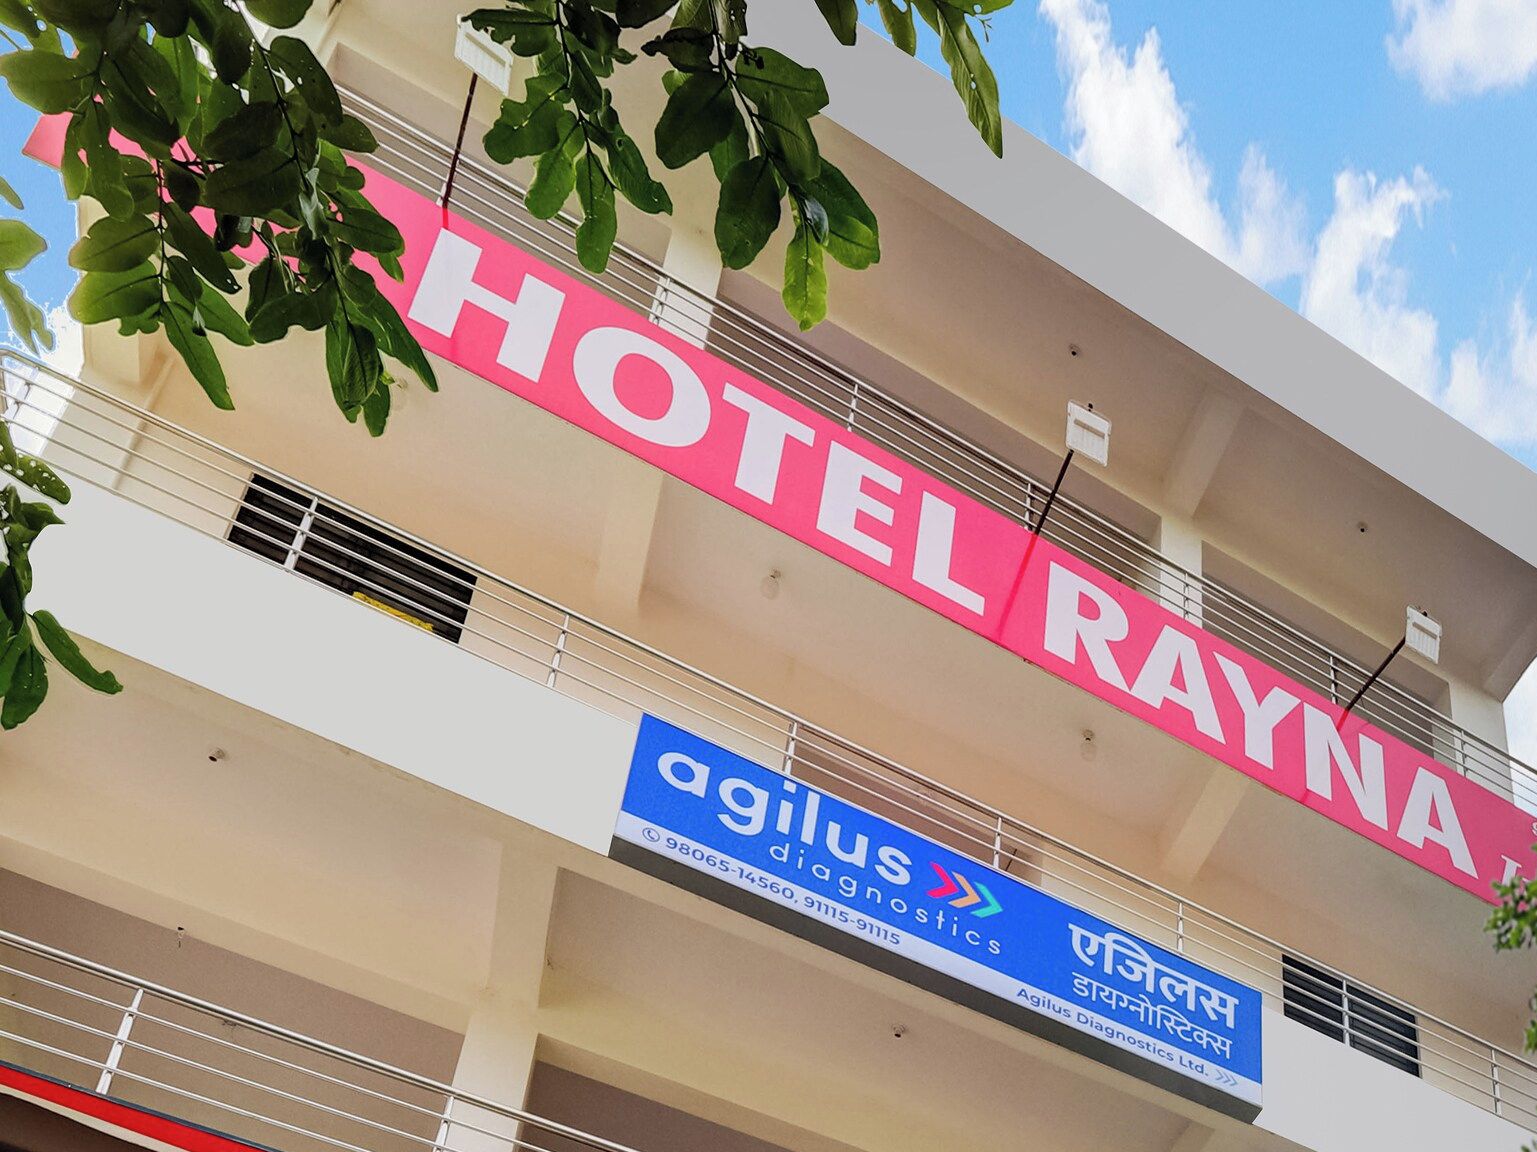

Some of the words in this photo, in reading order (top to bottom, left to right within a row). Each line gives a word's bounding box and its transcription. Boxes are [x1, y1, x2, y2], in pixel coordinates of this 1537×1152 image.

[408, 228, 985, 617] HOTEL
[1044, 560, 1478, 879] RAYNA
[657, 752, 912, 885] agilus
[769, 843, 1000, 954] diagnostics
[804, 896, 900, 945] 91115-91115
[1068, 922, 1239, 1029] एजिलस
[1072, 971, 1233, 1059] डायग्नोस्टिक्स
[1017, 988, 1071, 1018] Agilus
[1076, 1011, 1174, 1062] Diagnostics
[1179, 1054, 1209, 1077] Ltd.
